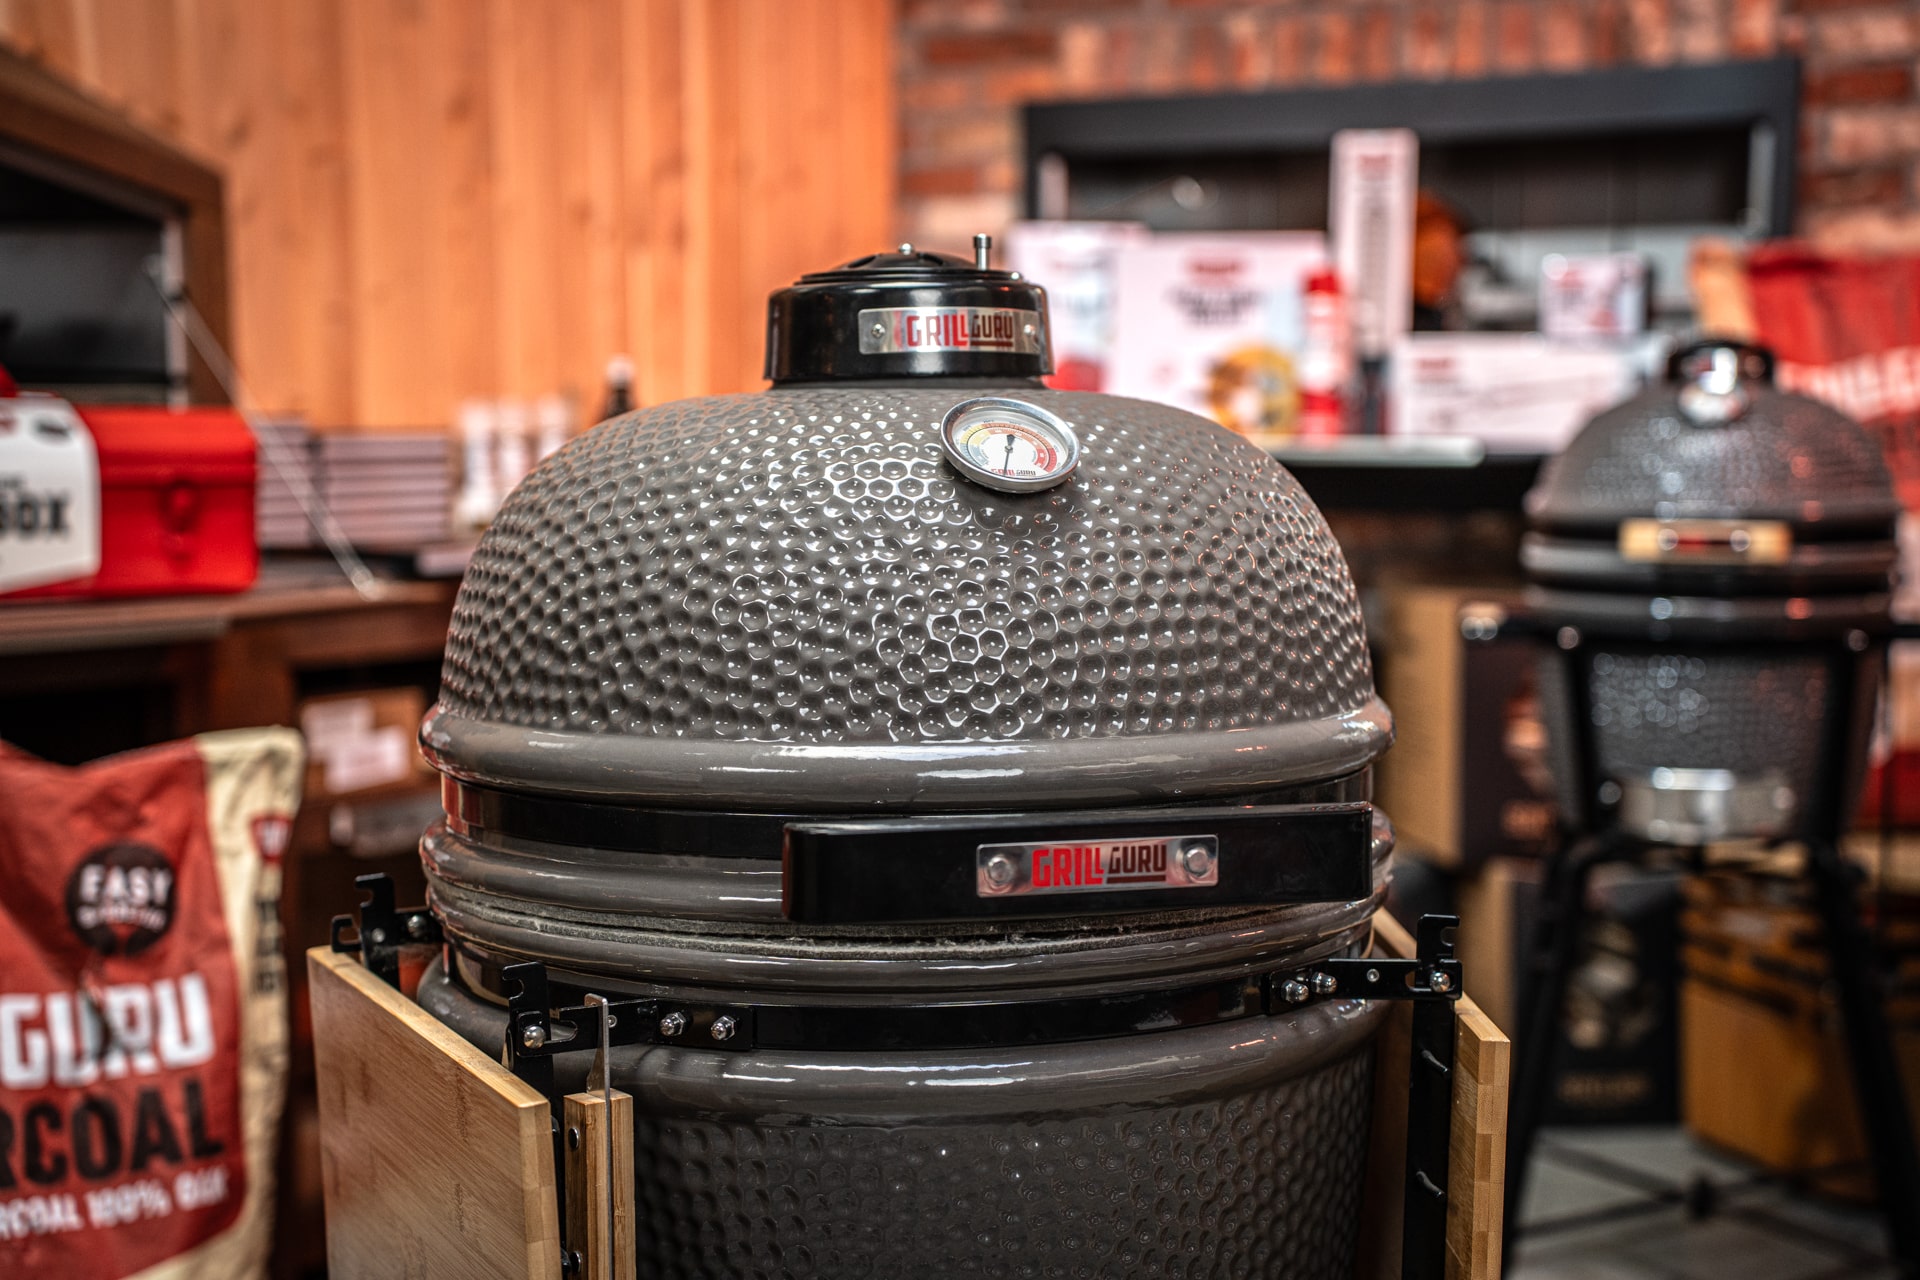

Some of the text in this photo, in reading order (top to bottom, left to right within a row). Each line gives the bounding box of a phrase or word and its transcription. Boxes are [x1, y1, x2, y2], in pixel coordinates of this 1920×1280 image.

[906, 314, 1013, 347] GRILL GURU
[1032, 844, 1167, 888] GRILL GURU
[0, 973, 214, 1090] GURU
